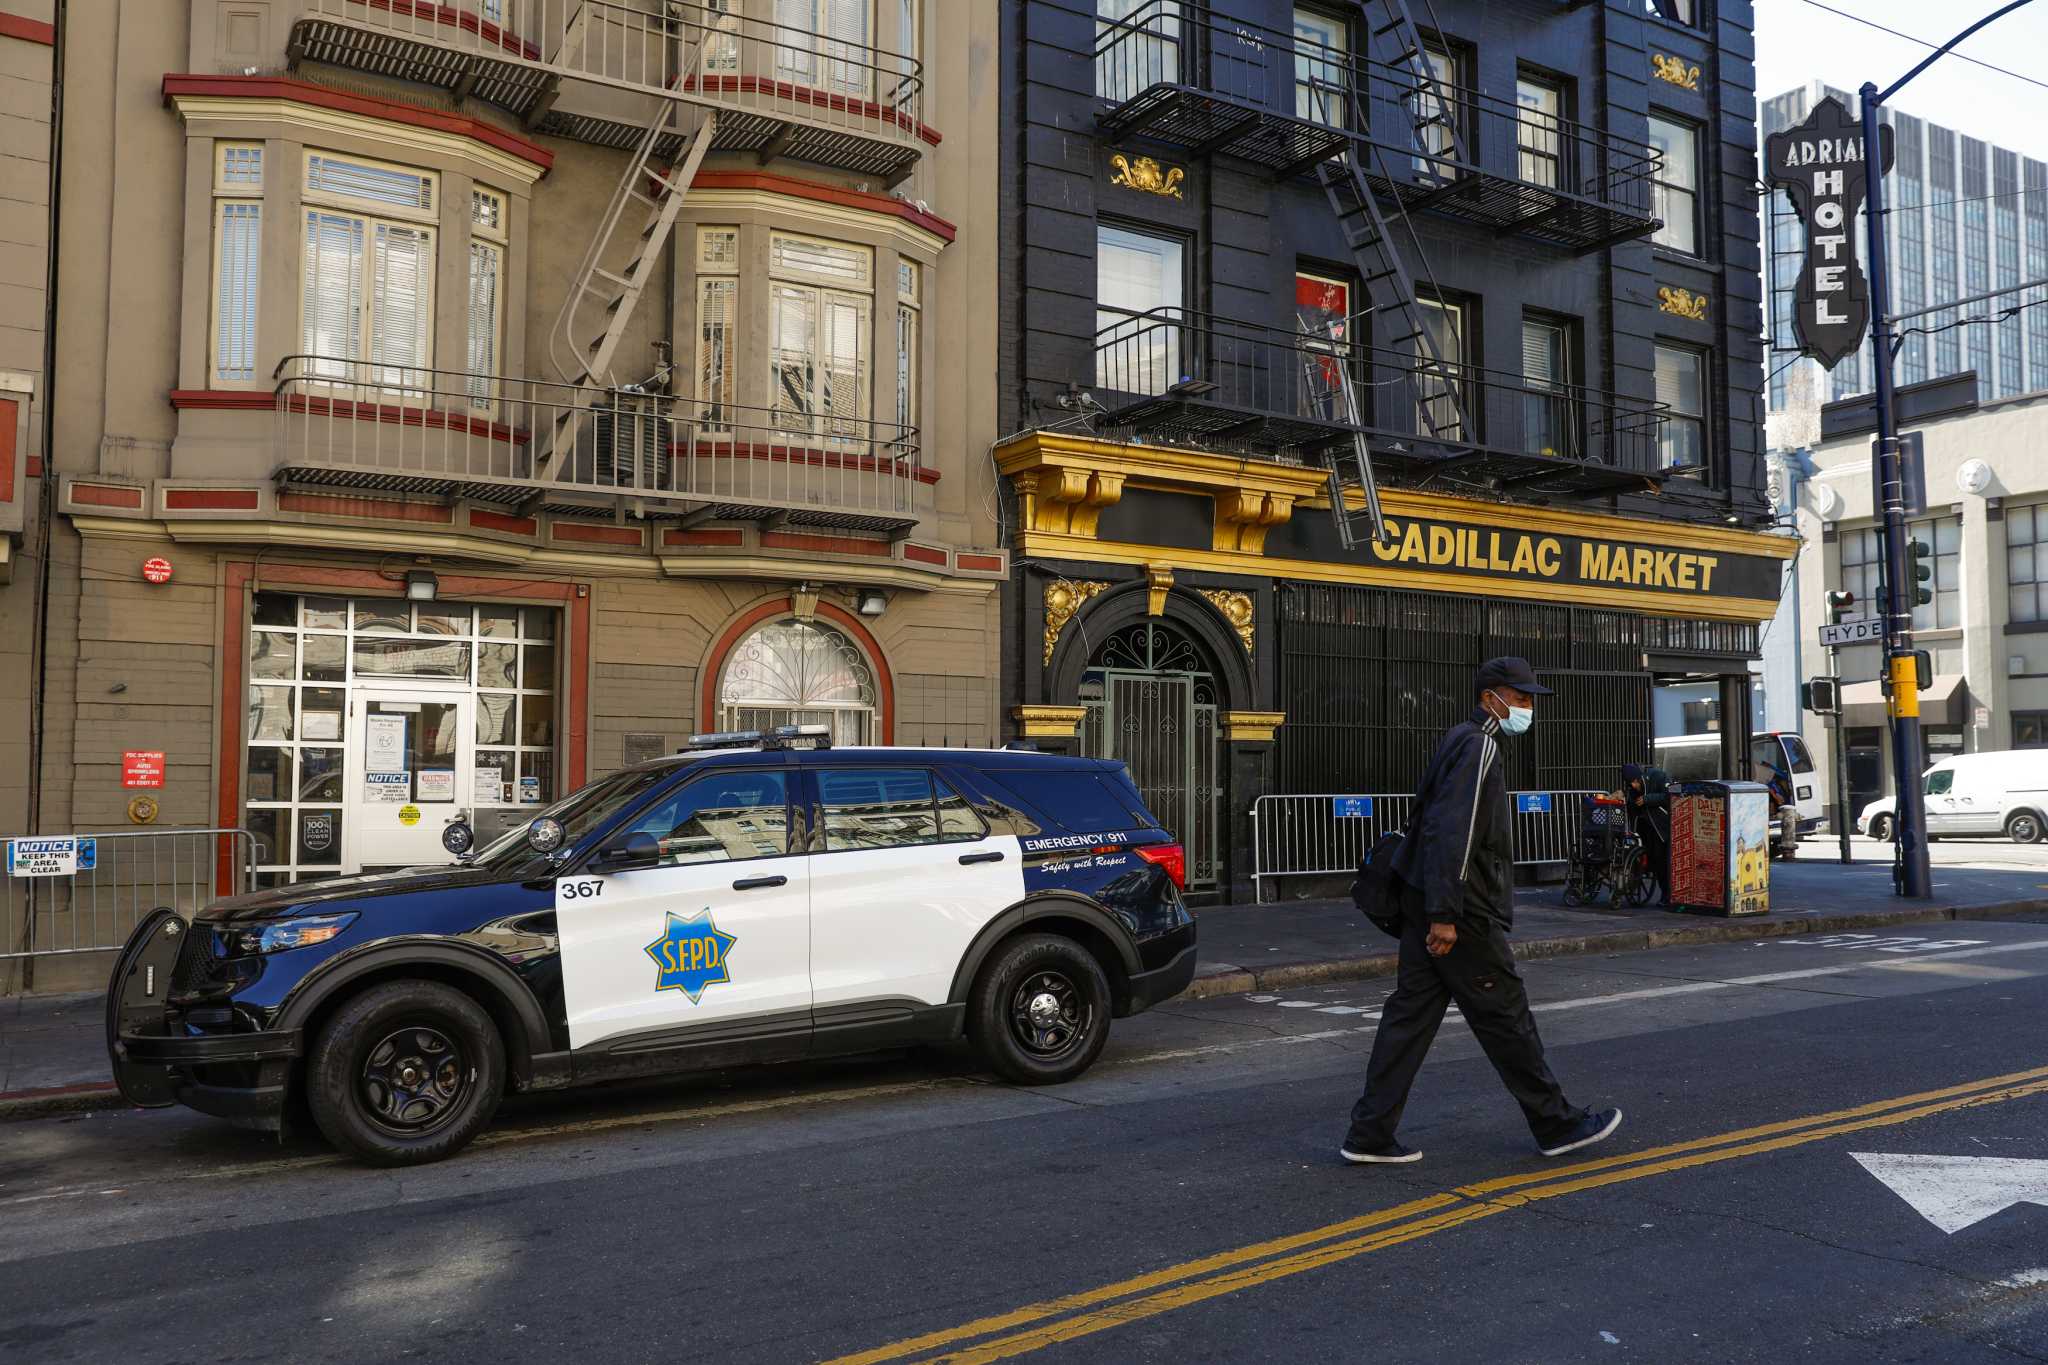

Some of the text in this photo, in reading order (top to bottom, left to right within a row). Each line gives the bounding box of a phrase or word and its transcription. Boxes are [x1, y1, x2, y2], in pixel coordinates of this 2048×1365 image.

[1813, 169, 1848, 325] HOTEL
[1372, 519, 1718, 592] CADILLAC MARKET
[1827, 622, 1881, 641] HYDE
[367, 774, 408, 783] NOTICE
[20, 840, 72, 852] NOTICE
[1025, 832, 1128, 850] EMERGENCY 911
[1041, 856, 1127, 873] Safety with Respect
[561, 879, 605, 900] 367
[662, 936, 721, 975] S.F.P.D.
